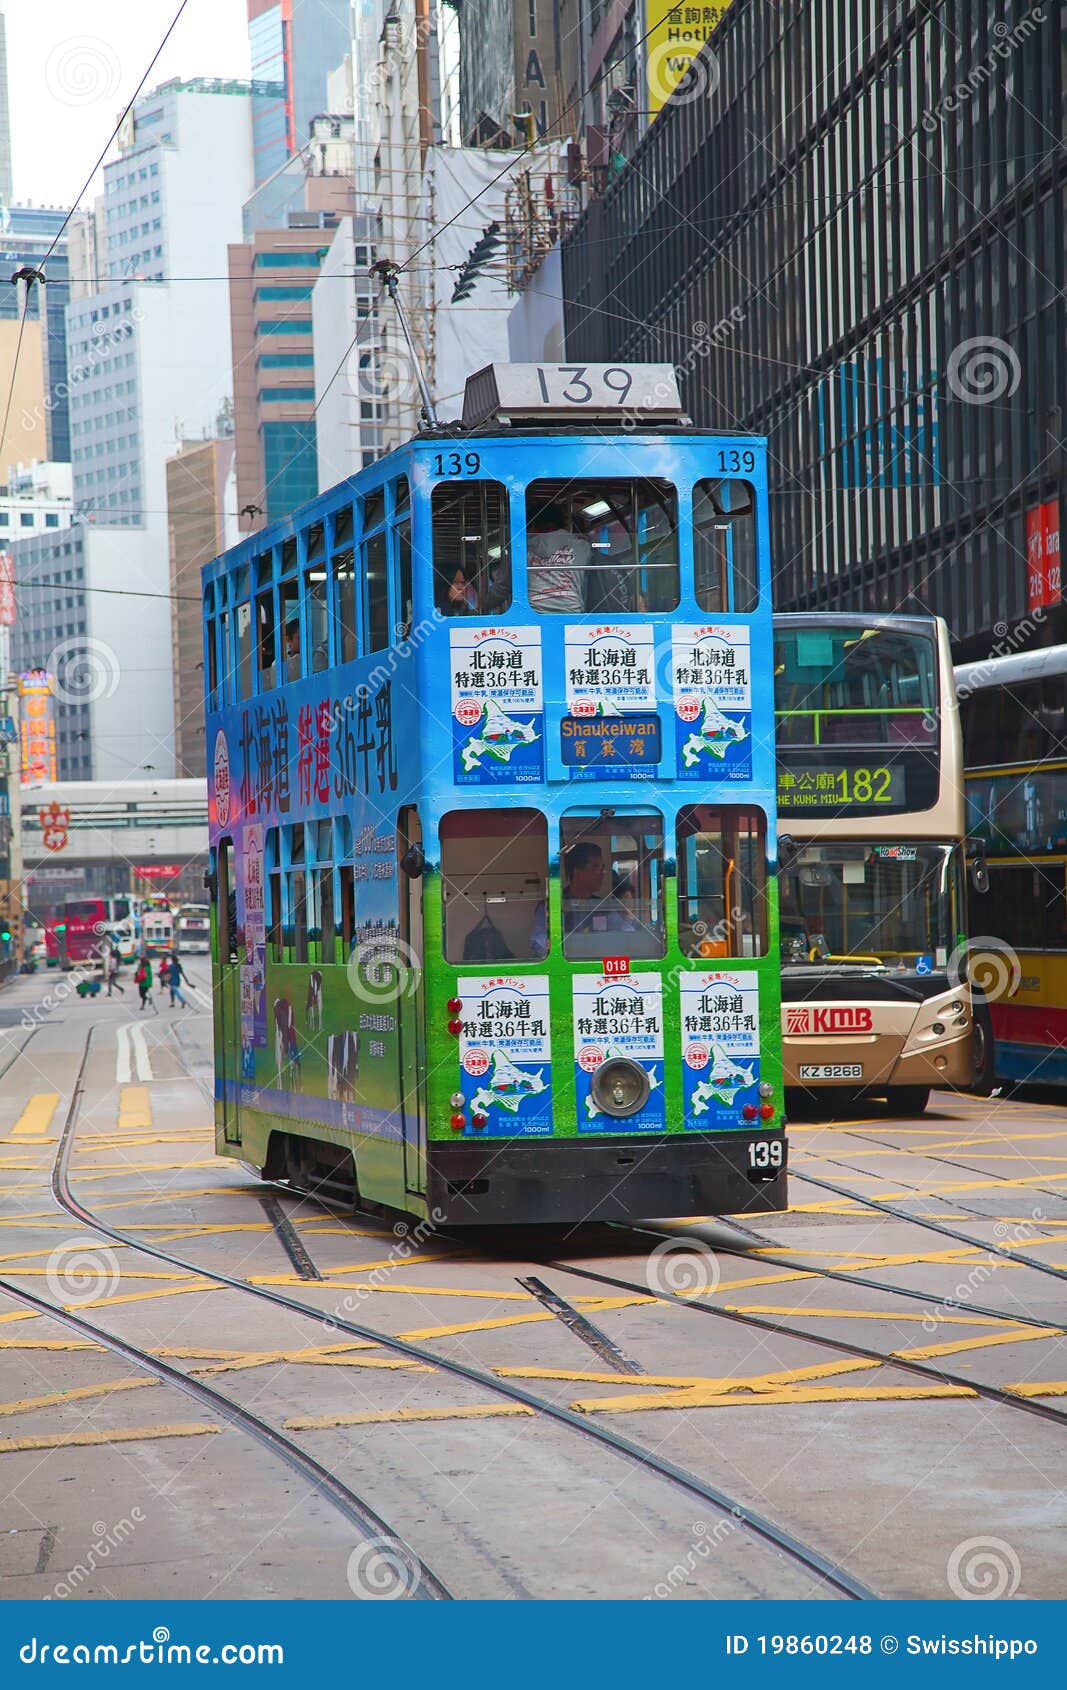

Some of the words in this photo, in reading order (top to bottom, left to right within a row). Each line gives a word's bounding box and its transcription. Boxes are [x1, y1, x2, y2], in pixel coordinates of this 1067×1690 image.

[537, 367, 632, 404] 139
[434, 452, 480, 476] 139
[718, 450, 755, 472] 139
[474, 628, 518, 640] 生産地パック
[588, 626, 632, 638] 生産地パック
[469, 650, 523, 669] 北海道
[584, 648, 636, 667] 北海道
[689, 648, 736, 667] 北海道
[455, 670, 539, 688] 特選3.6牛乳
[569, 668, 651, 685] 特選3.6牛乳
[676, 668, 748, 685] 特選3.6牛乳
[562, 721, 656, 737] Shaukeiwan
[239, 696, 290, 820] 北海道
[778, 772, 835, 791] 車公廟
[836, 767, 893, 803] 182
[776, 795, 791, 805] HE
[793, 794, 818, 805] KUNG
[820, 793, 840, 804] MIU
[881, 846, 917, 858] RoadShow
[605, 960, 627, 972] 018
[481, 978, 526, 991] 生産地パック
[477, 1000, 531, 1019] 北海道
[592, 997, 645, 1016] 北海道
[697, 994, 744, 1014] 北海道
[578, 1017, 660, 1034] 特選3.6牛乳
[684, 1015, 757, 1032] 特選3.6牛乳
[813, 1007, 873, 1032] KMB
[462, 1020, 547, 1038] 特選3.6牛乳
[801, 1067, 820, 1077] KZ
[823, 1066, 861, 1077] 9268
[748, 1140, 783, 1168] 139
